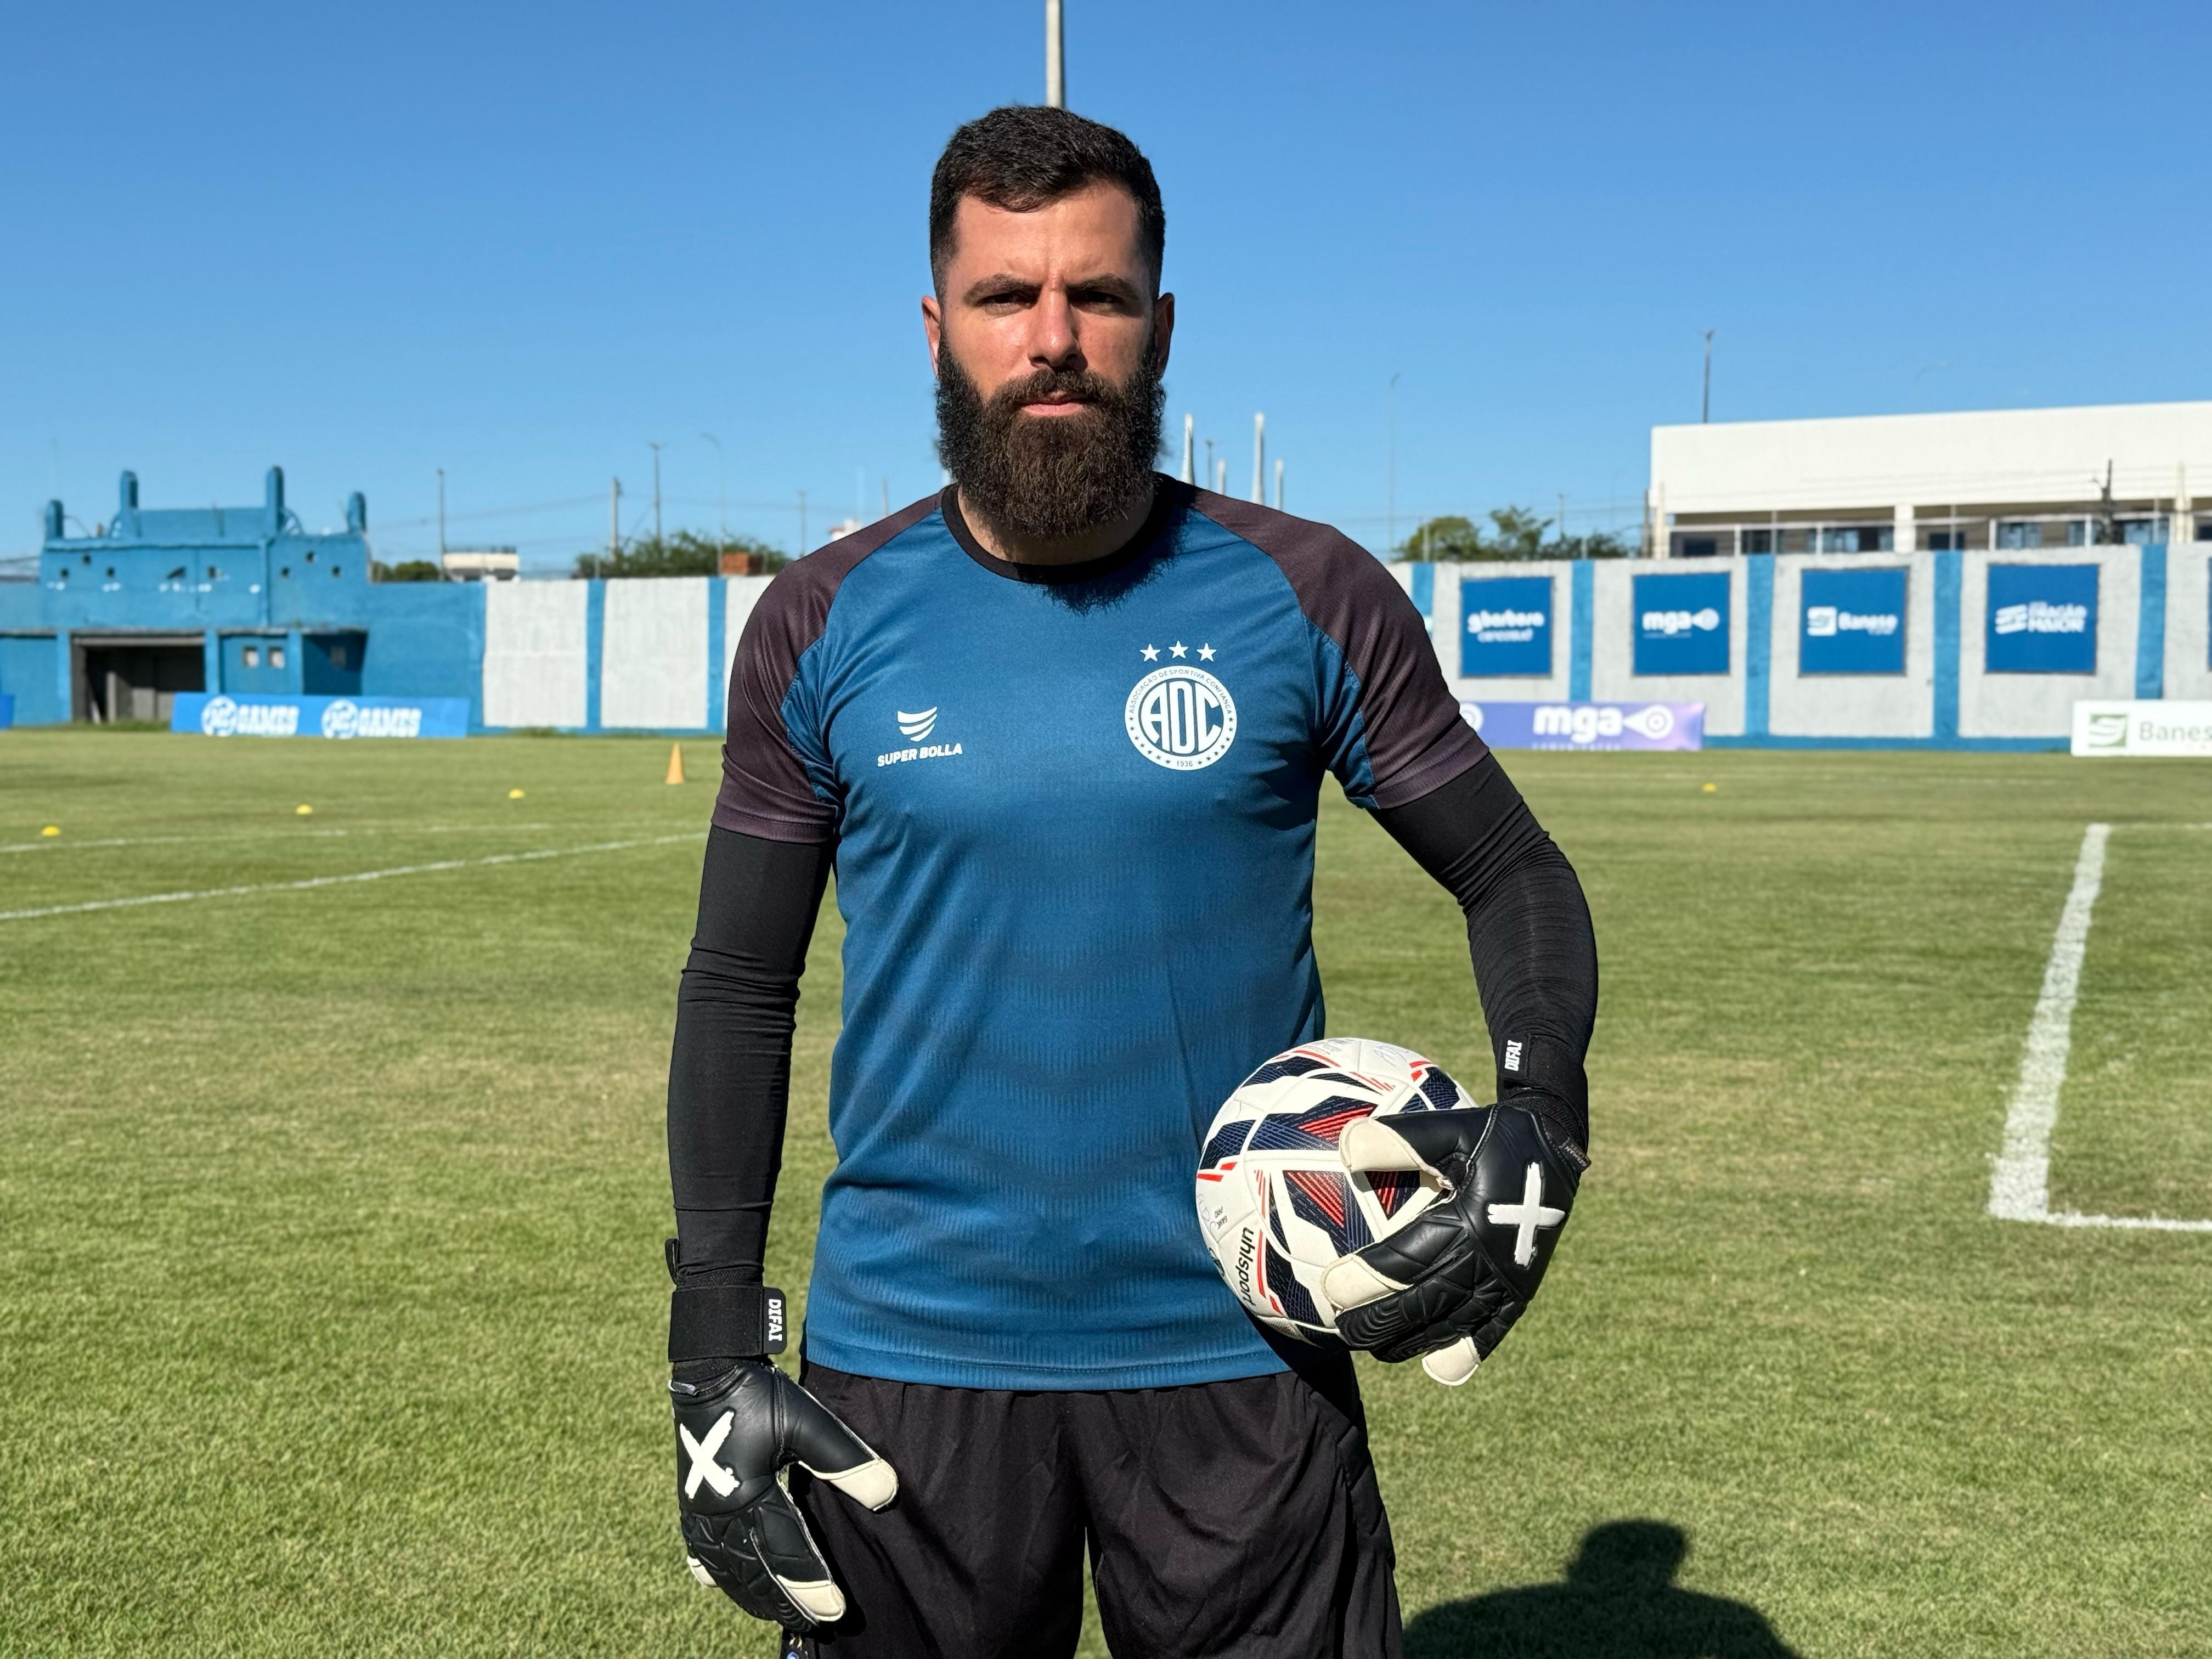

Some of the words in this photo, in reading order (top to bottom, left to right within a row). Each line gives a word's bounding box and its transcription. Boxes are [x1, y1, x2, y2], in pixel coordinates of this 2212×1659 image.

[1643, 611, 1691, 634] mga
[1159, 669, 1205, 680] DESPORTIVA
[1206, 676, 1232, 715] CONFIANÇA
[1141, 680, 1223, 754] ADC
[1533, 706, 1623, 744] mga
[877, 748, 918, 767] SUPER
[919, 743, 962, 759] BOLLA
[1504, 1040, 1522, 1071] DIFAI
[1564, 1146, 1587, 1167] GERMAN
[1235, 1227, 1256, 1306] uhlsport
[768, 1299, 782, 1341] DIFAI
